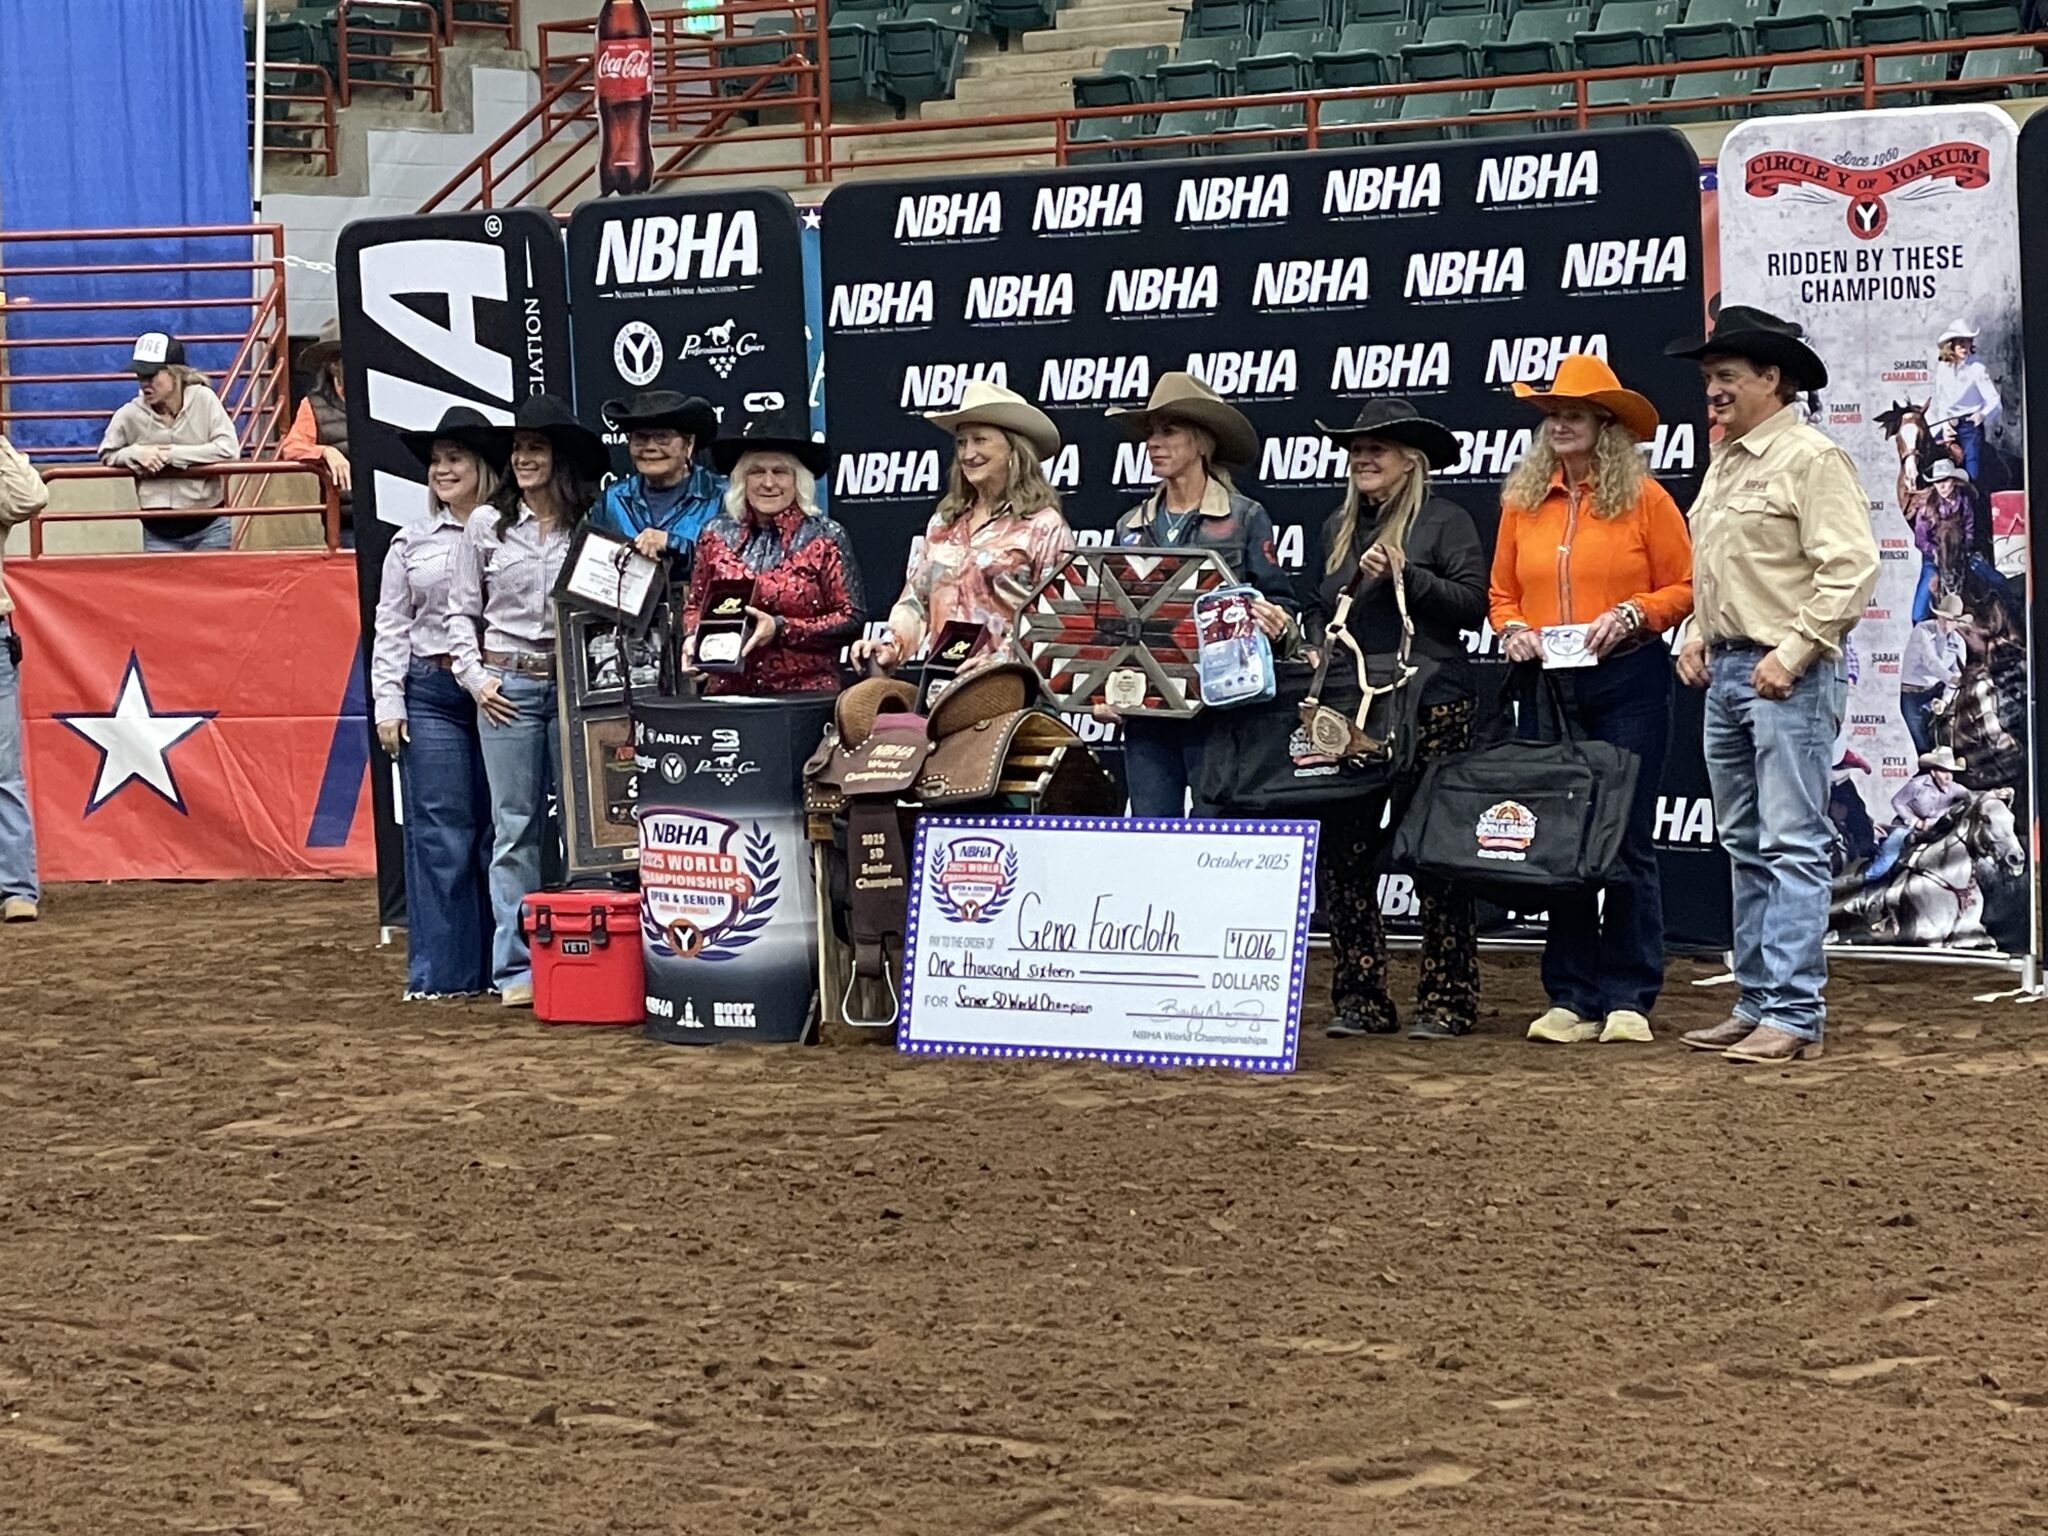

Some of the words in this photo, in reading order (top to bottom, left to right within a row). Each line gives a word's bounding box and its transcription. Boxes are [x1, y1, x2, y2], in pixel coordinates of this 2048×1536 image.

[1750, 155, 1829, 182] CIRCLE
[1837, 172, 1851, 188] Y
[1857, 178, 1877, 190] OF
[1886, 148, 1981, 185] YOAKUM
[1833, 151, 1869, 167] Since
[1323, 163, 1441, 213] NBHA
[1476, 151, 1598, 204] NBHA
[1033, 183, 1143, 230] NBHA
[1175, 174, 1289, 221] NBHA
[895, 192, 1001, 239] NBHA
[596, 211, 758, 286] NBHA
[1562, 236, 1686, 288] NBHA
[1768, 251, 1847, 276] RIDDEN
[1856, 249, 1884, 273] BY
[1891, 245, 1964, 271] THESE
[1253, 258, 1369, 306] NBHA
[1404, 248, 1525, 298] NBHA
[965, 273, 1073, 320] NBHA
[1106, 266, 1218, 313] NBHA
[1801, 275, 1936, 303] CHAMPIONS
[829, 281, 934, 327] NBHA
[524, 298, 549, 397] CIATION
[1039, 356, 1150, 402] NBHA
[1331, 343, 1450, 390] NBHA
[835, 450, 938, 496] NBHA
[1872, 653, 1900, 663] SARAH
[1851, 715, 1886, 725] MARTHA
[1852, 726, 1877, 736] JOSEY
[656, 733, 702, 746] ARIAT
[1882, 757, 1908, 766] KEYLA
[652, 822, 708, 846] NBHA
[1653, 797, 1714, 843] HA
[861, 833, 886, 846] 2025
[960, 846, 992, 858] NBHA
[667, 854, 734, 873] WORLD
[1197, 852, 1254, 870] October
[1255, 853, 1291, 871] 2025
[683, 894, 725, 906] SENIOR
[1018, 891, 1077, 951] Gena
[1088, 894, 1180, 953] Faircloth
[563, 941, 589, 953] YETI
[929, 936, 942, 948] PAY
[942, 936, 950, 948] TO
[950, 936, 964, 948] THE
[963, 936, 986, 949] ORDER
[986, 938, 995, 950] OF
[927, 951, 956, 977] One
[963, 950, 1021, 979] thousand
[1027, 960, 1075, 979] sixteen
[1212, 972, 1280, 991] DOLLARS
[713, 1002, 755, 1015] BOOT
[924, 994, 948, 1007] FOR
[1008, 992, 1038, 1010] World
[1040, 993, 1093, 1014] Champion
[713, 1014, 757, 1028] BARN
[1133, 1029, 1162, 1040] NBHA
[1164, 1031, 1192, 1041] World
[1194, 1034, 1268, 1046] Championships
